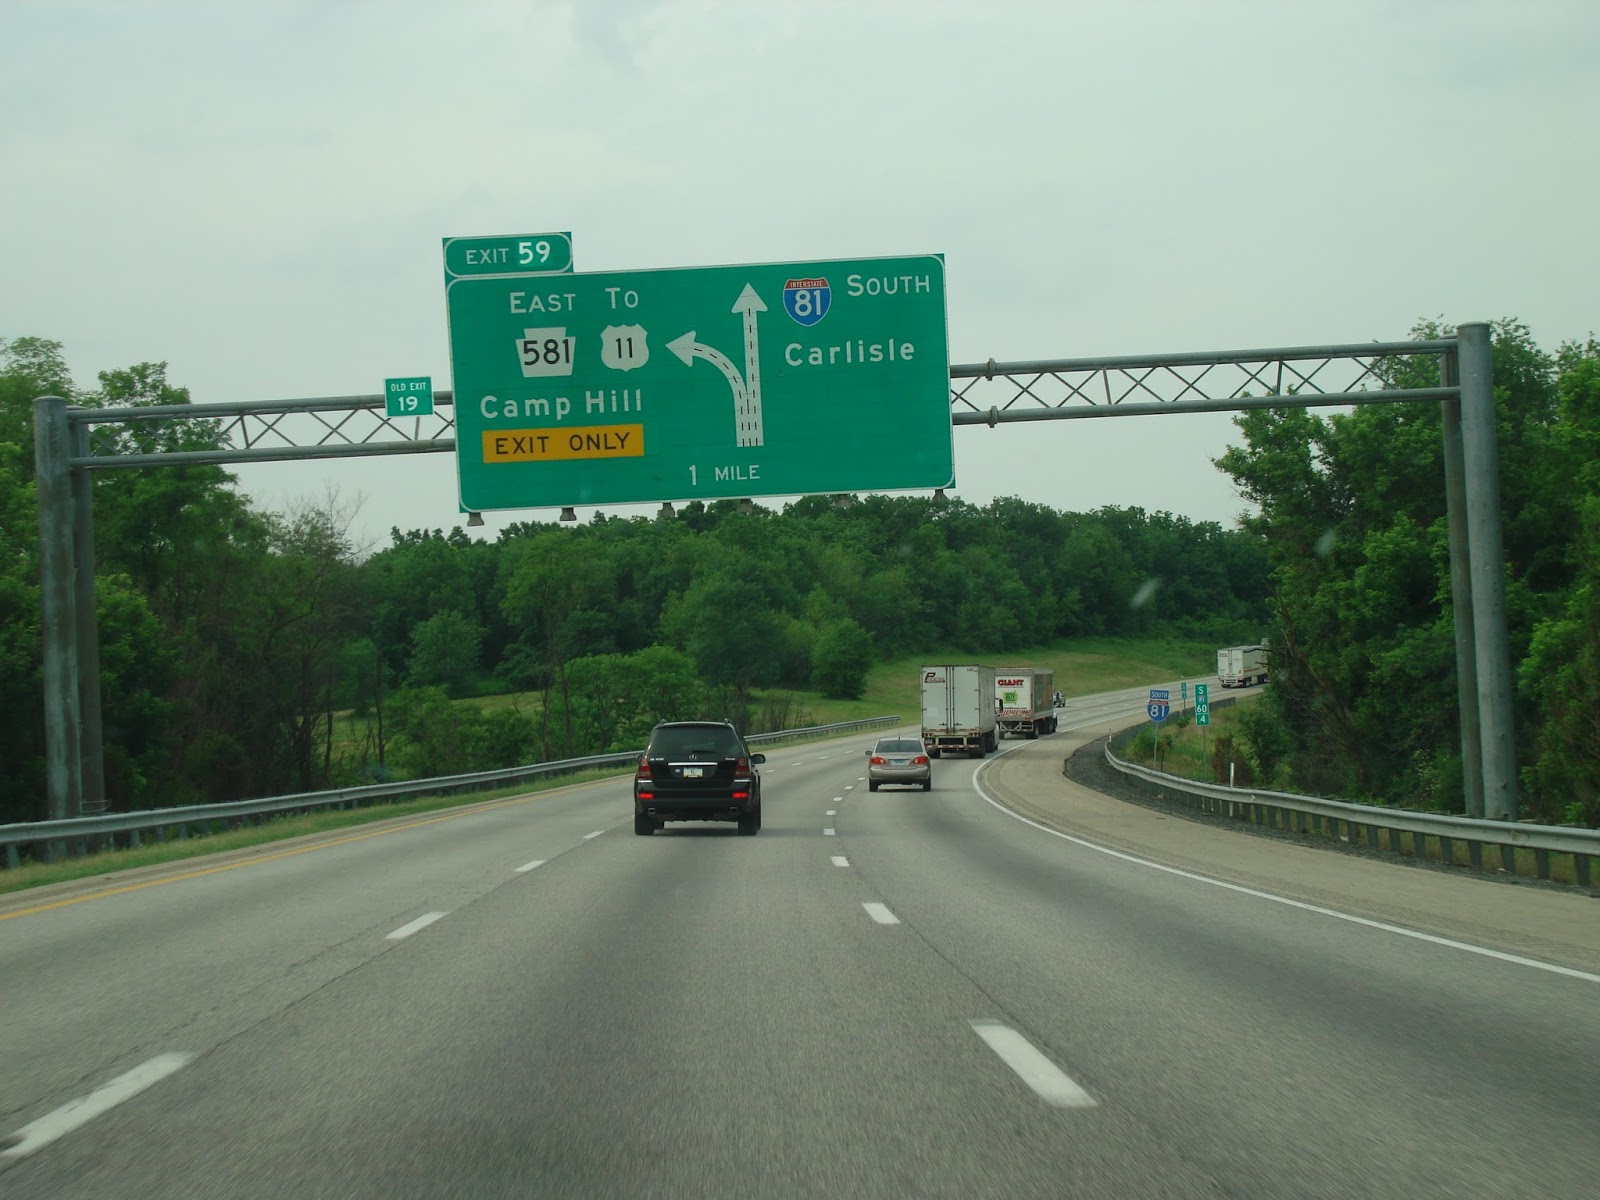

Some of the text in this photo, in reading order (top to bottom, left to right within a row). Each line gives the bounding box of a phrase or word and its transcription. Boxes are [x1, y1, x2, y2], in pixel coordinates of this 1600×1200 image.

[466, 240, 551, 265] EXIT 59
[790, 280, 823, 288] INTERSTATE
[847, 274, 930, 297] SOUTH
[509, 291, 576, 314] EAST
[605, 287, 639, 309] TO
[795, 289, 821, 317] 81
[523, 338, 570, 366] 581
[615, 337, 633, 359] 11
[784, 338, 915, 367] Carlisle
[390, 382, 426, 391] OLD EXIT
[397, 395, 418, 411] 19
[480, 389, 642, 421] Camp Hill
[495, 432, 630, 455] EXIT ONLY
[688, 464, 760, 486] 1 MILE
[1151, 691, 1168, 699] SOUTH
[1199, 686, 1204, 695] S
[1150, 705, 1165, 718] 81
[1196, 704, 1207, 713] 60
